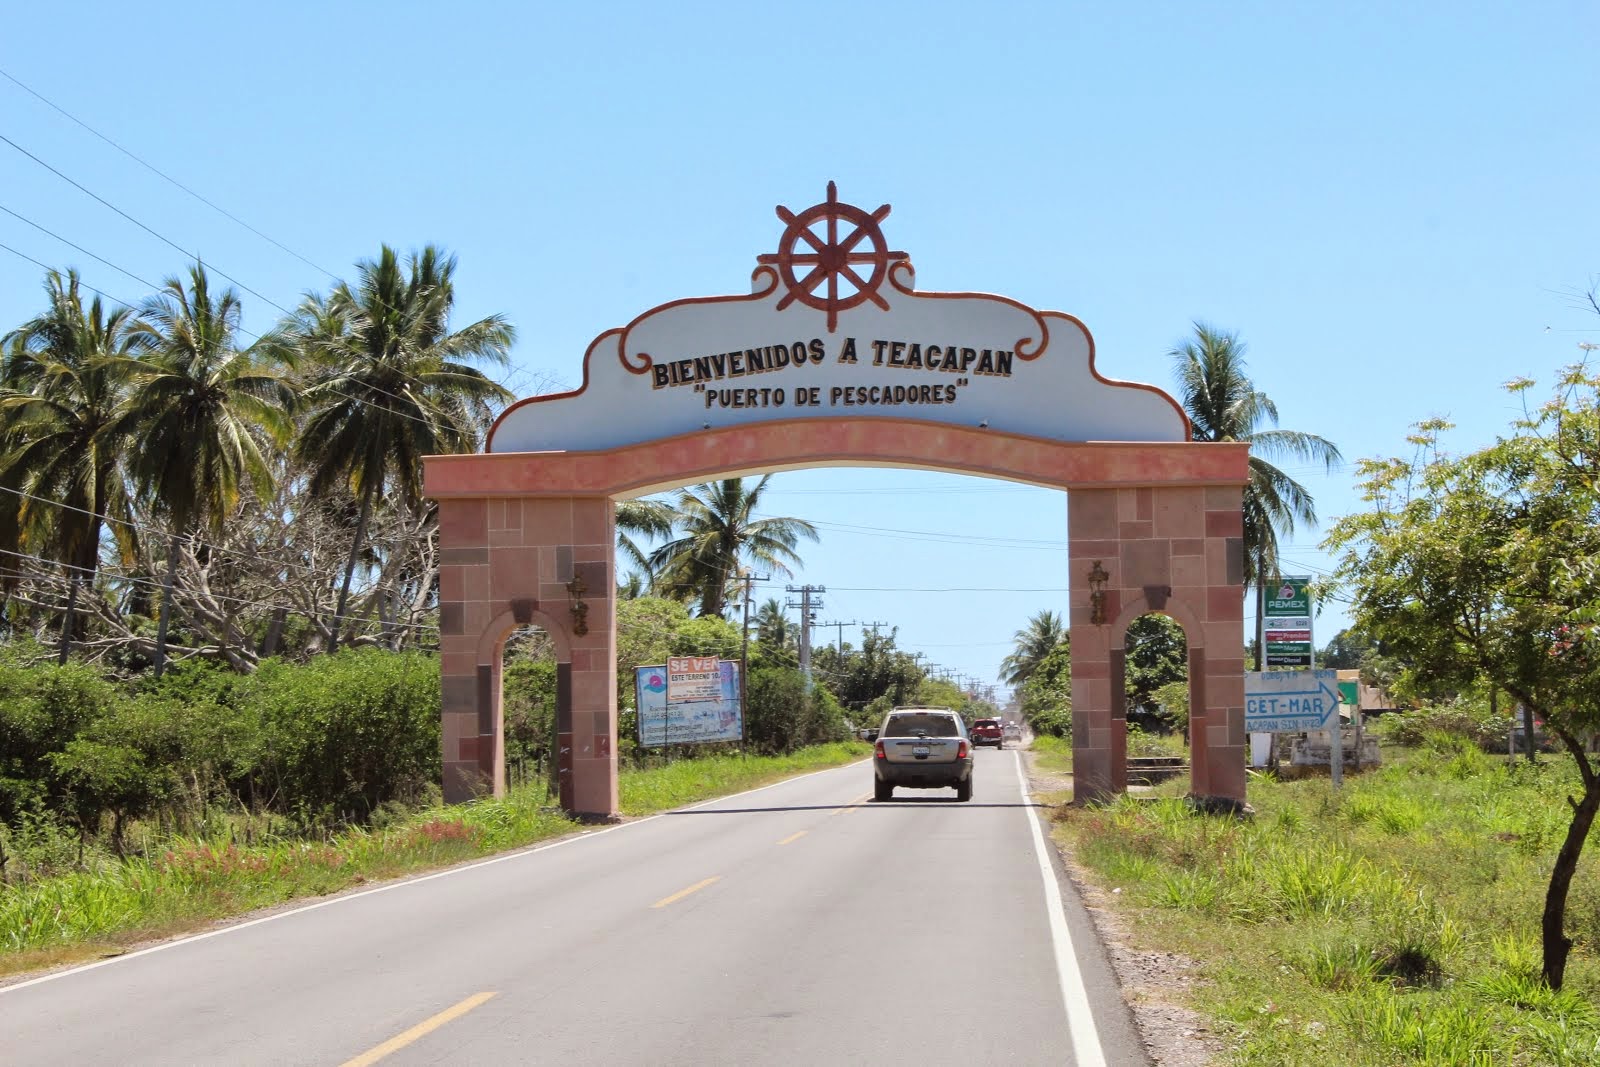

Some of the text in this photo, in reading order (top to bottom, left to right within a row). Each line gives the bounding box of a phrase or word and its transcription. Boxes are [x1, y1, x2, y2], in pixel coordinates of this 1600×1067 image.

[652, 337, 1014, 390] BIENVENIDOS A TEACAPAN
[693, 378, 968, 409] "PUERTO DE PESCADORES"
[1268, 600, 1306, 608] PEMEX
[671, 660, 689, 672] SE
[686, 672, 710, 681] TERRENO
[1247, 698, 1323, 714] CET-MAR
